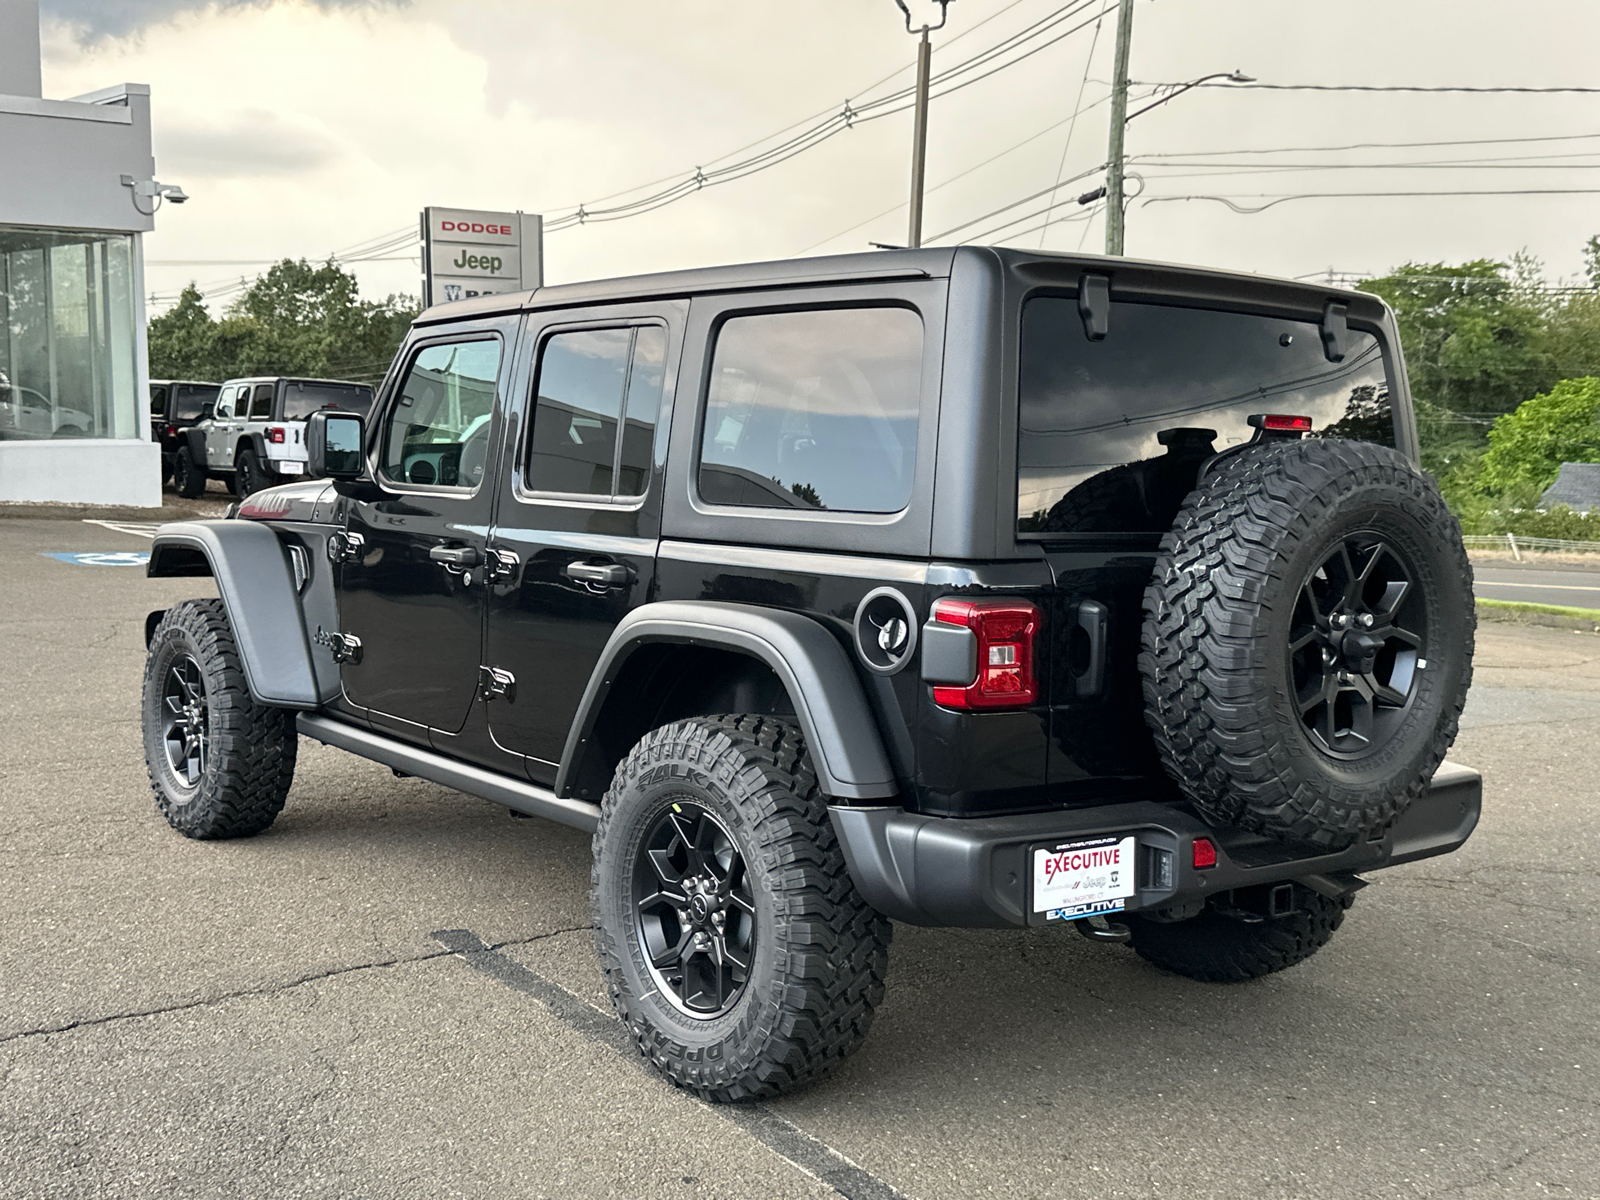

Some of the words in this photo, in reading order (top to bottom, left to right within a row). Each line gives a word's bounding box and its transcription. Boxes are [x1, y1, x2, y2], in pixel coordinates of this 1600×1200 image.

[441, 220, 511, 235] DODGE
[453, 249, 502, 274] Jeep
[1045, 849, 1120, 885] EXECUTIVE
[1046, 898, 1125, 920] EXECUTIVE
